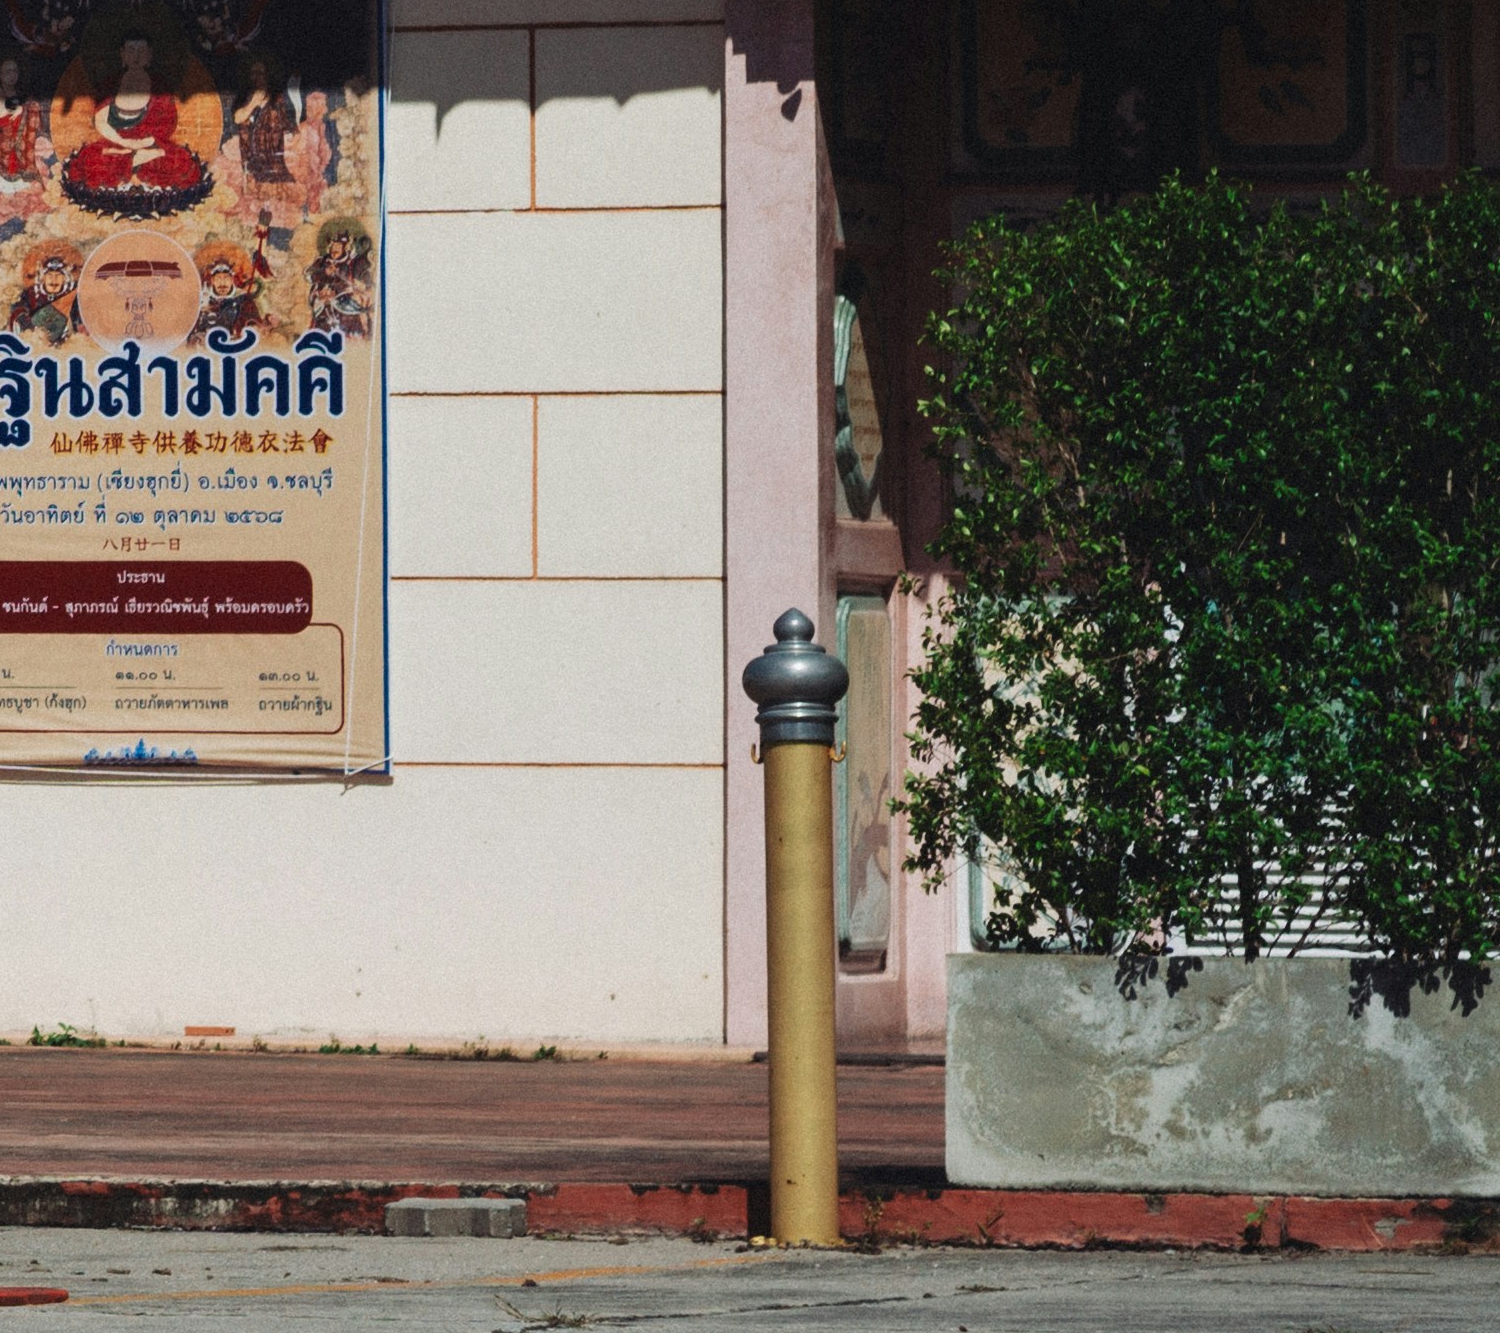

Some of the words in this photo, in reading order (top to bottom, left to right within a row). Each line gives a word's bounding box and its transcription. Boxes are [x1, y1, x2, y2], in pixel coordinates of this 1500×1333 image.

[49, 428, 334, 455] 仙佛禪寺供養功德衣法會
[199, 469, 258, 491] อ.เมือง
[267, 466, 333, 497] จ.ชลบุรี
[0, 500, 85, 525] วันอาทิตย์
[94, 493, 106, 524] ที่
[115, 509, 145, 525] ๑๒
[154, 509, 216, 531] ตุลาคม
[224, 508, 285, 525] ๒๕๖๘
[102, 536, 181, 553] 八月廿一日
[116, 568, 165, 585] ประธาน
[65, 596, 119, 619] สุภาภรณ์
[214, 597, 310, 615] พร้อมครอบครัว
[105, 639, 179, 657] กำหนดการ
[259, 694, 332, 716] ถวายผ้ากฐิน
